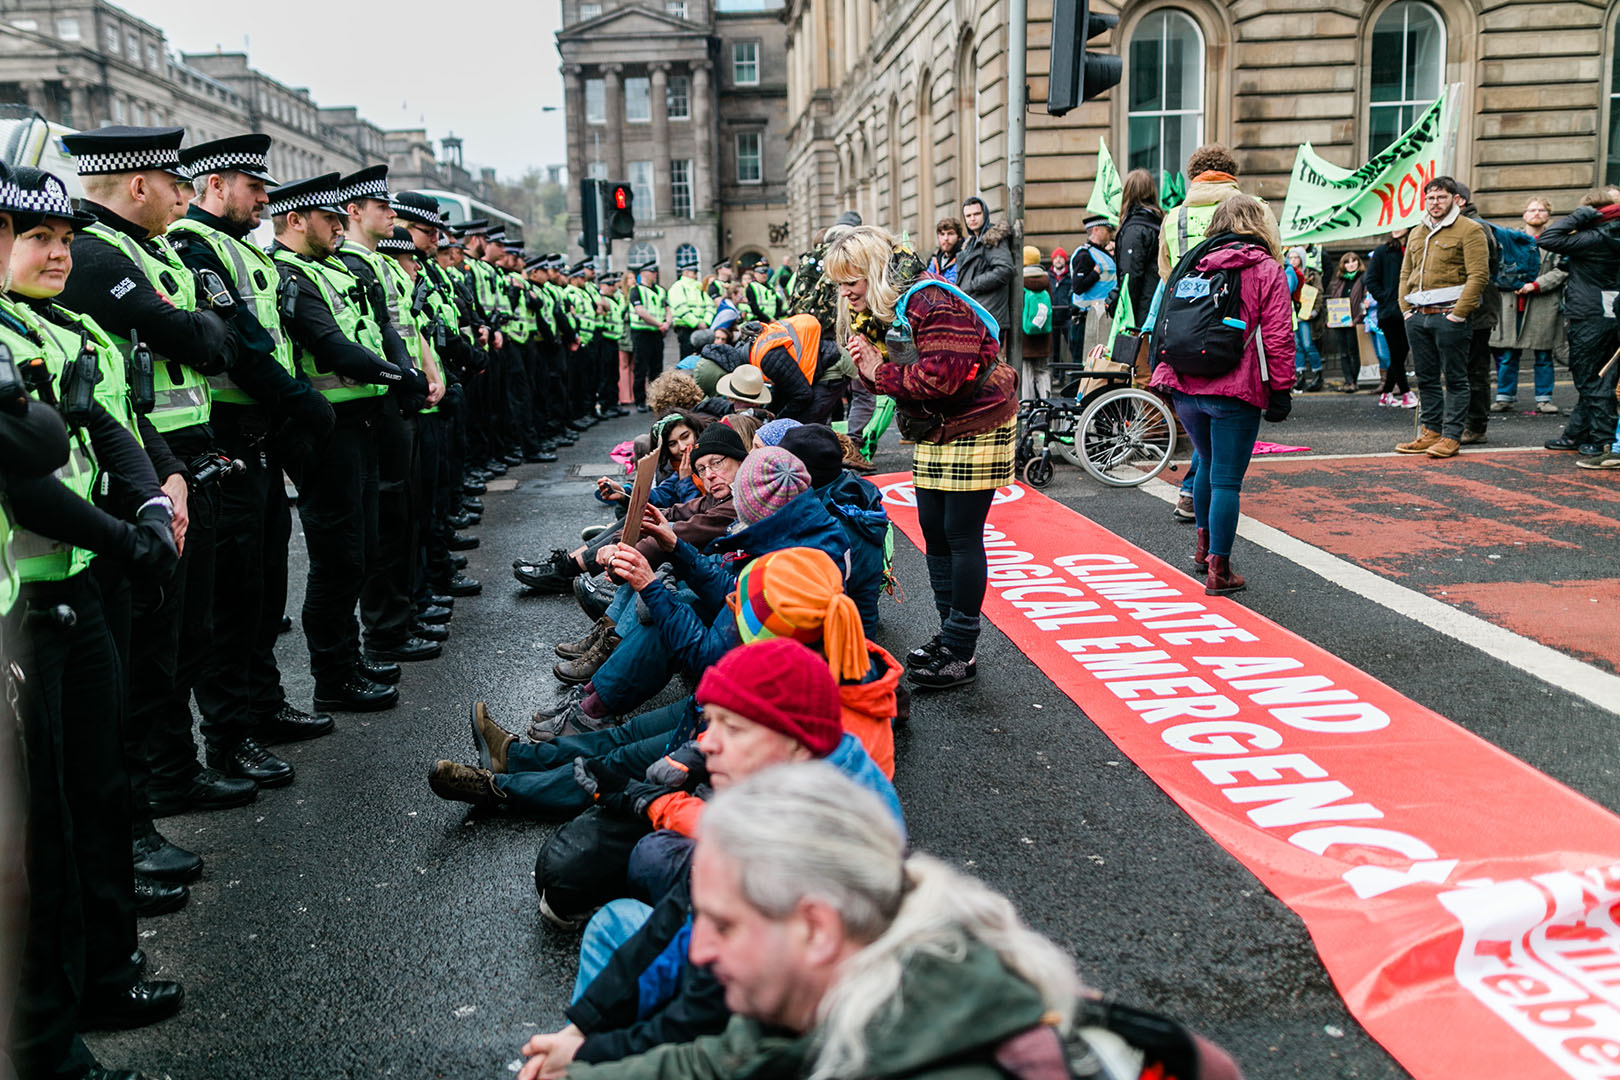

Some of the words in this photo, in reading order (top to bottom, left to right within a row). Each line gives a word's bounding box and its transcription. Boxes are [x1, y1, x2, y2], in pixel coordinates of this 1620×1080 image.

[1371, 160, 1435, 226] NOW
[110, 276, 132, 295] POLICE
[1053, 553, 1260, 646] CLIMATE
[1192, 656, 1391, 733] AND
[1474, 938, 1620, 1080] rebe
